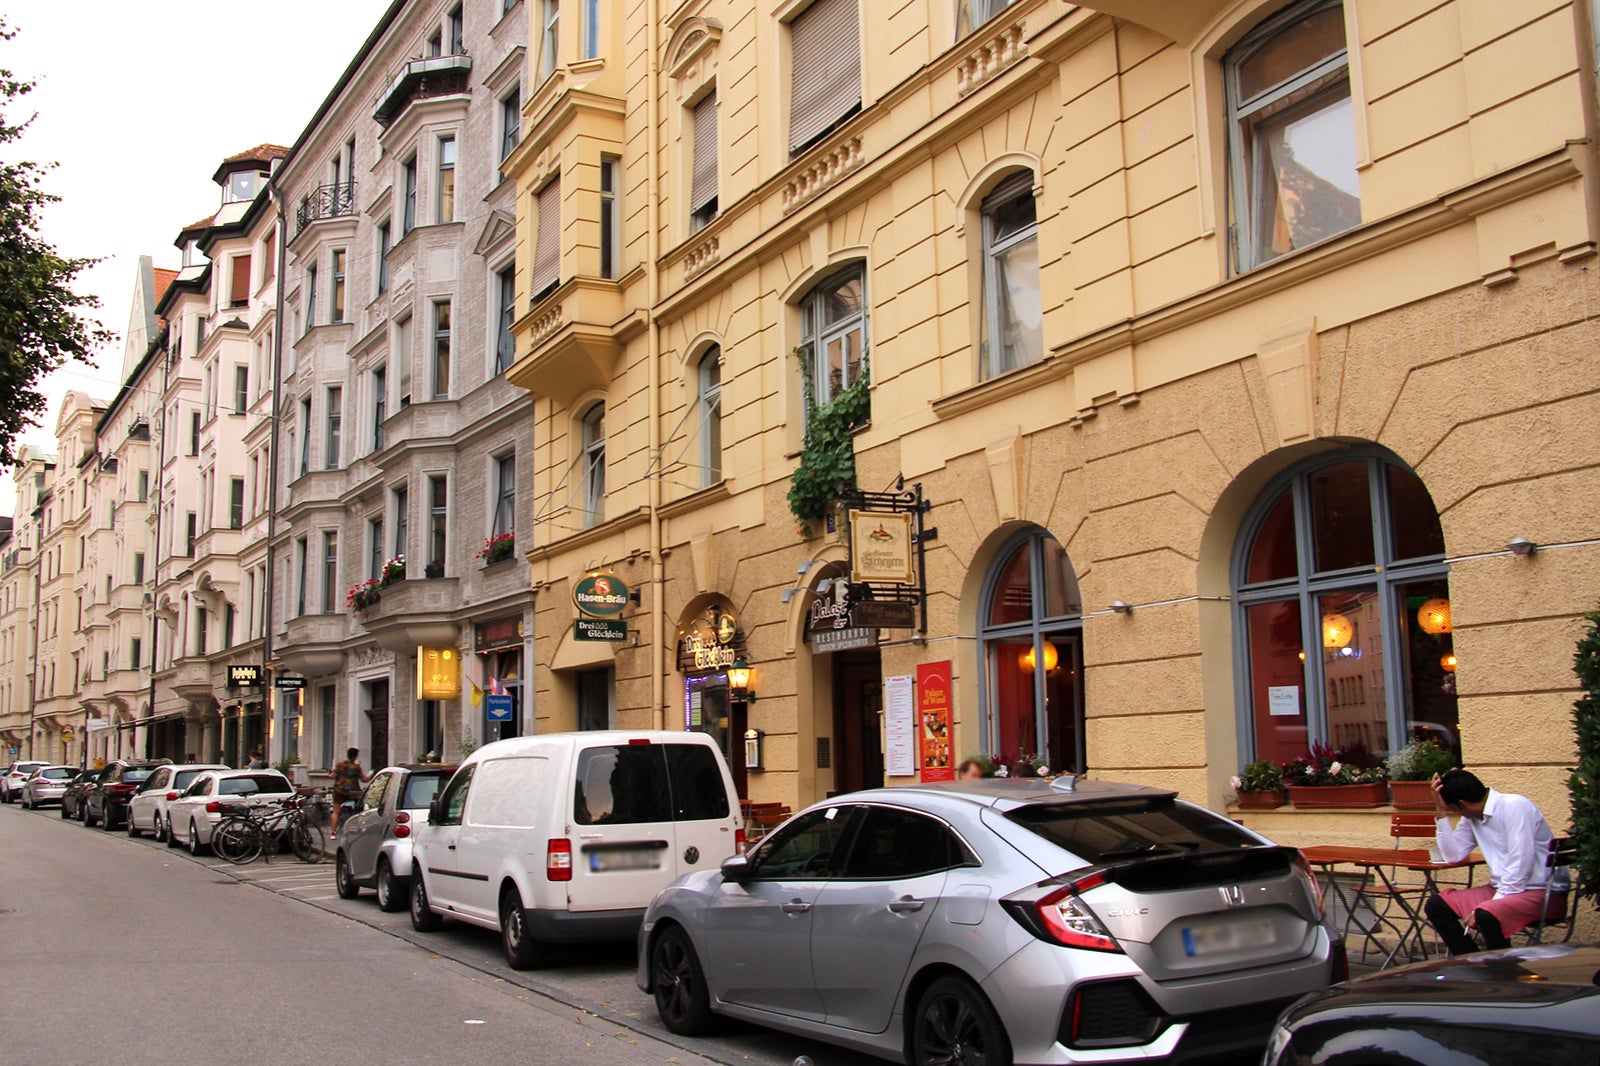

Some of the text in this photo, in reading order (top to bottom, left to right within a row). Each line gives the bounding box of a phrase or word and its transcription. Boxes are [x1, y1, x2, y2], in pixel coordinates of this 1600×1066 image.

[577, 592, 626, 604] Hasen-Bräu
[578, 621, 595, 630] Drei
[587, 629, 624, 639] Glöcklein
[1107, 907, 1149, 918] CIVIC
